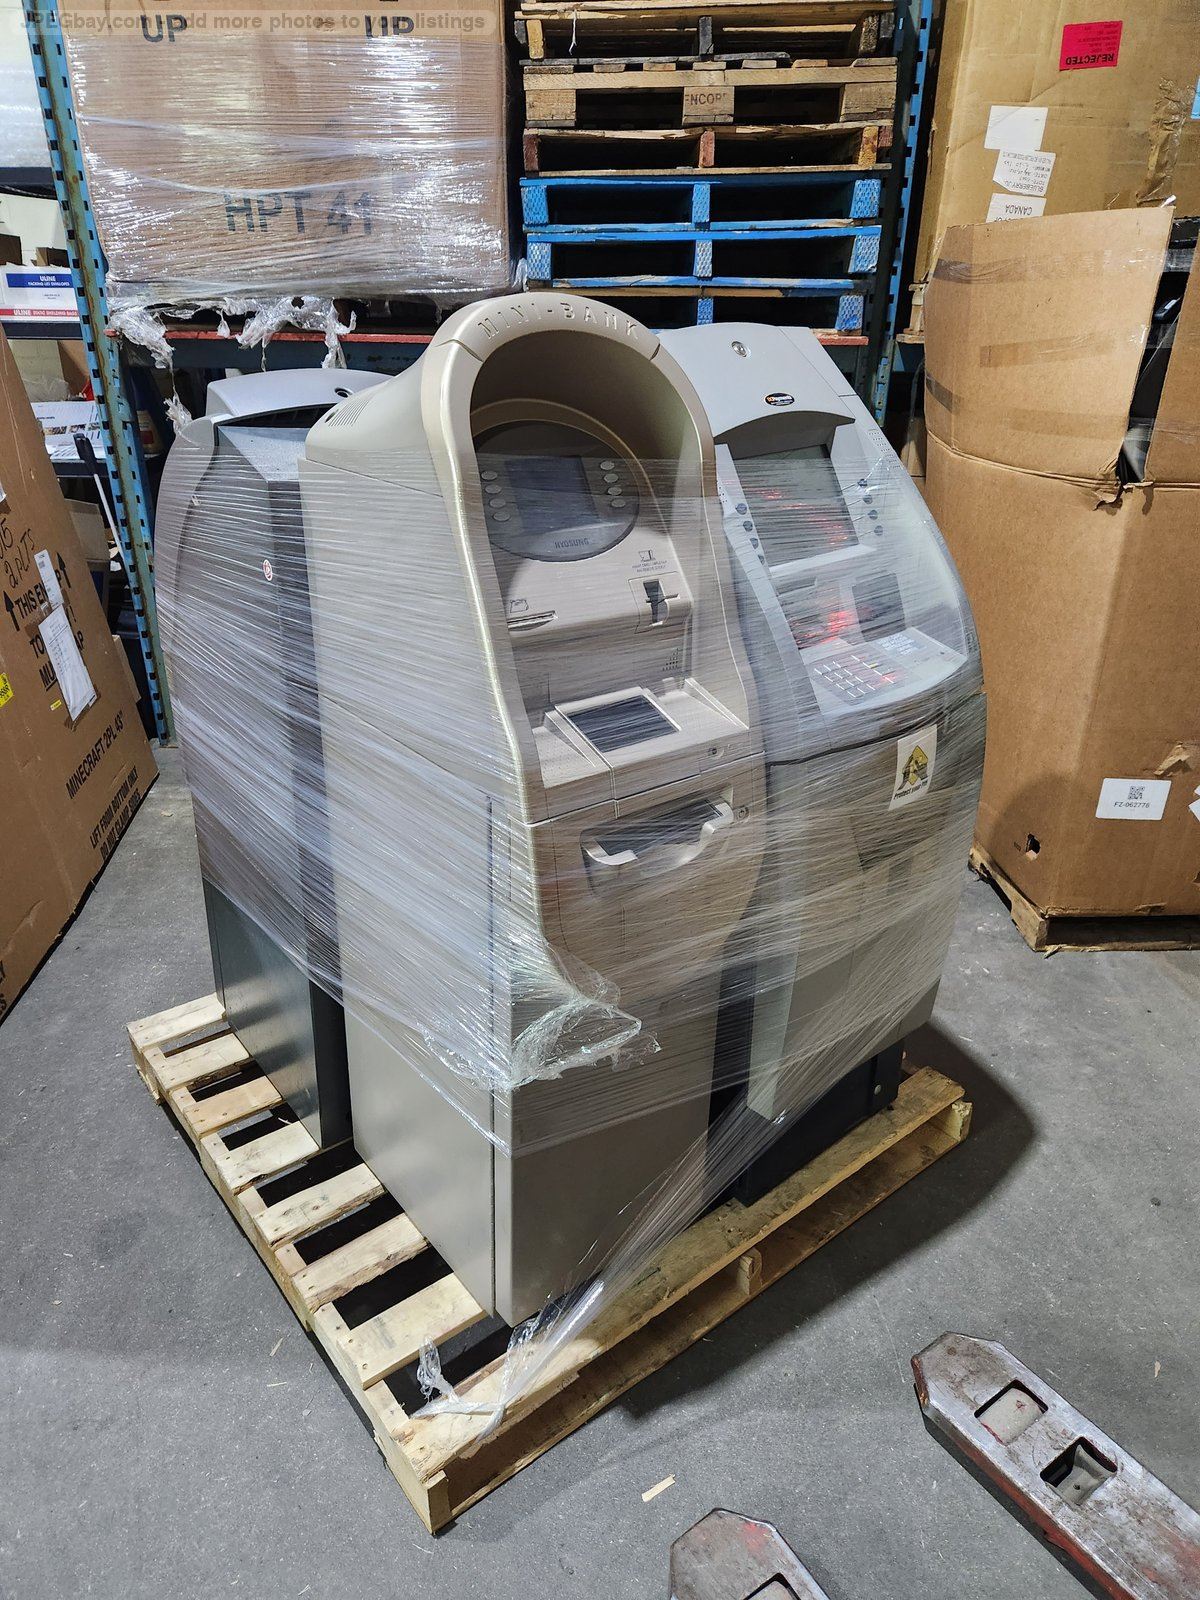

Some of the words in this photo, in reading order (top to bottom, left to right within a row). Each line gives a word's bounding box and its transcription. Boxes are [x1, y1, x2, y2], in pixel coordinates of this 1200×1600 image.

[140, 14, 188, 43] UP
[364, 14, 415, 39] UP
[1066, 53, 1115, 66] REJECTED
[223, 190, 312, 233] HPT
[1005, 204, 1033, 216] CANADA
[15, 590, 37, 620] THIS
[65, 737, 105, 800] MINECRAFT
[103, 724, 118, 749] 2PL
[89, 825, 102, 850] LIFT
